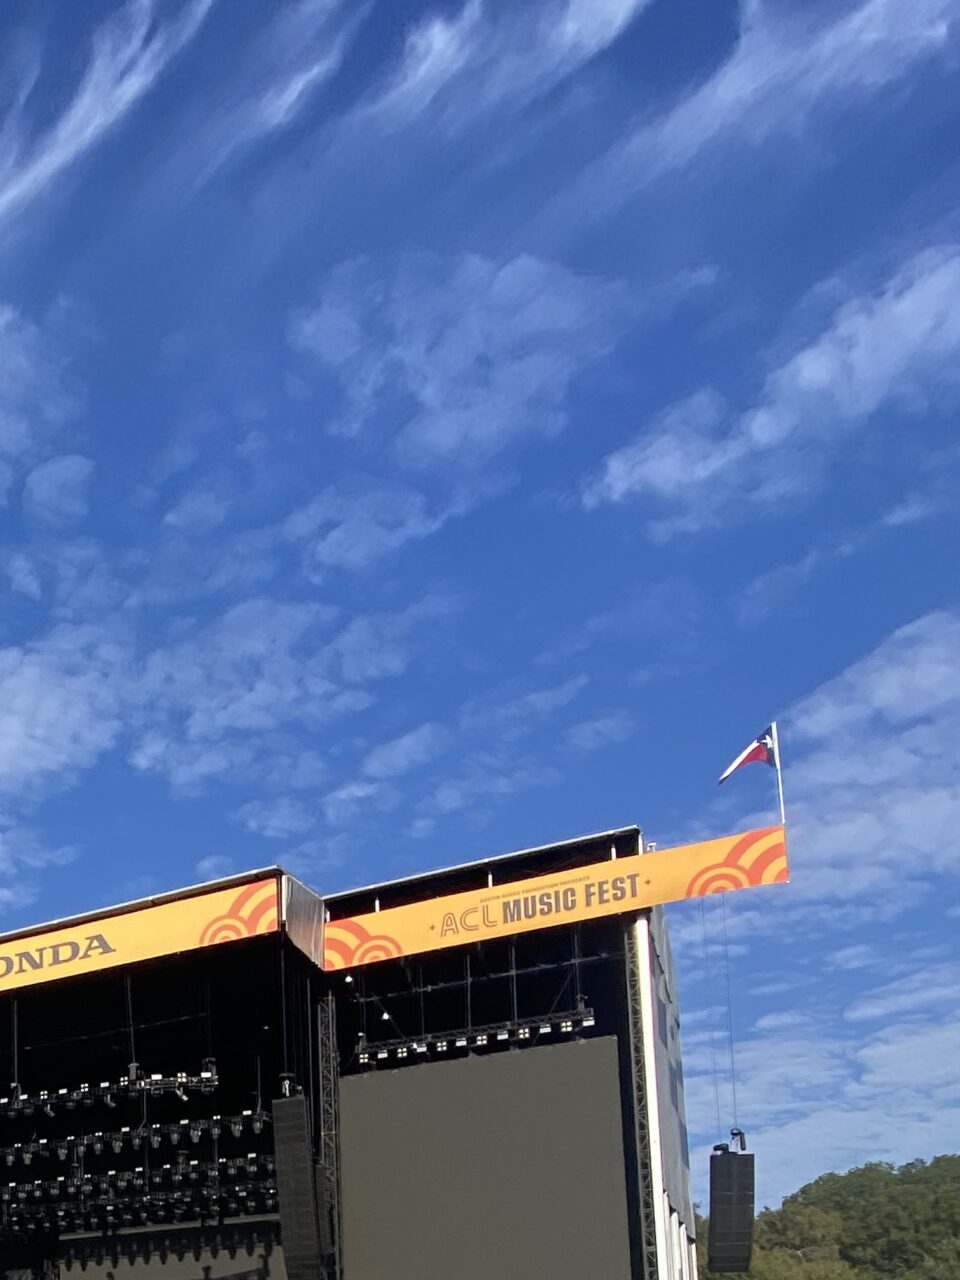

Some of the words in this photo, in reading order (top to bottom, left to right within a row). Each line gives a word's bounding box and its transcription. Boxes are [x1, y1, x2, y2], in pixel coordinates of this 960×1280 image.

[440, 904, 498, 938] ACL
[502, 886, 577, 924] MUSIC
[584, 873, 640, 908] FEST
